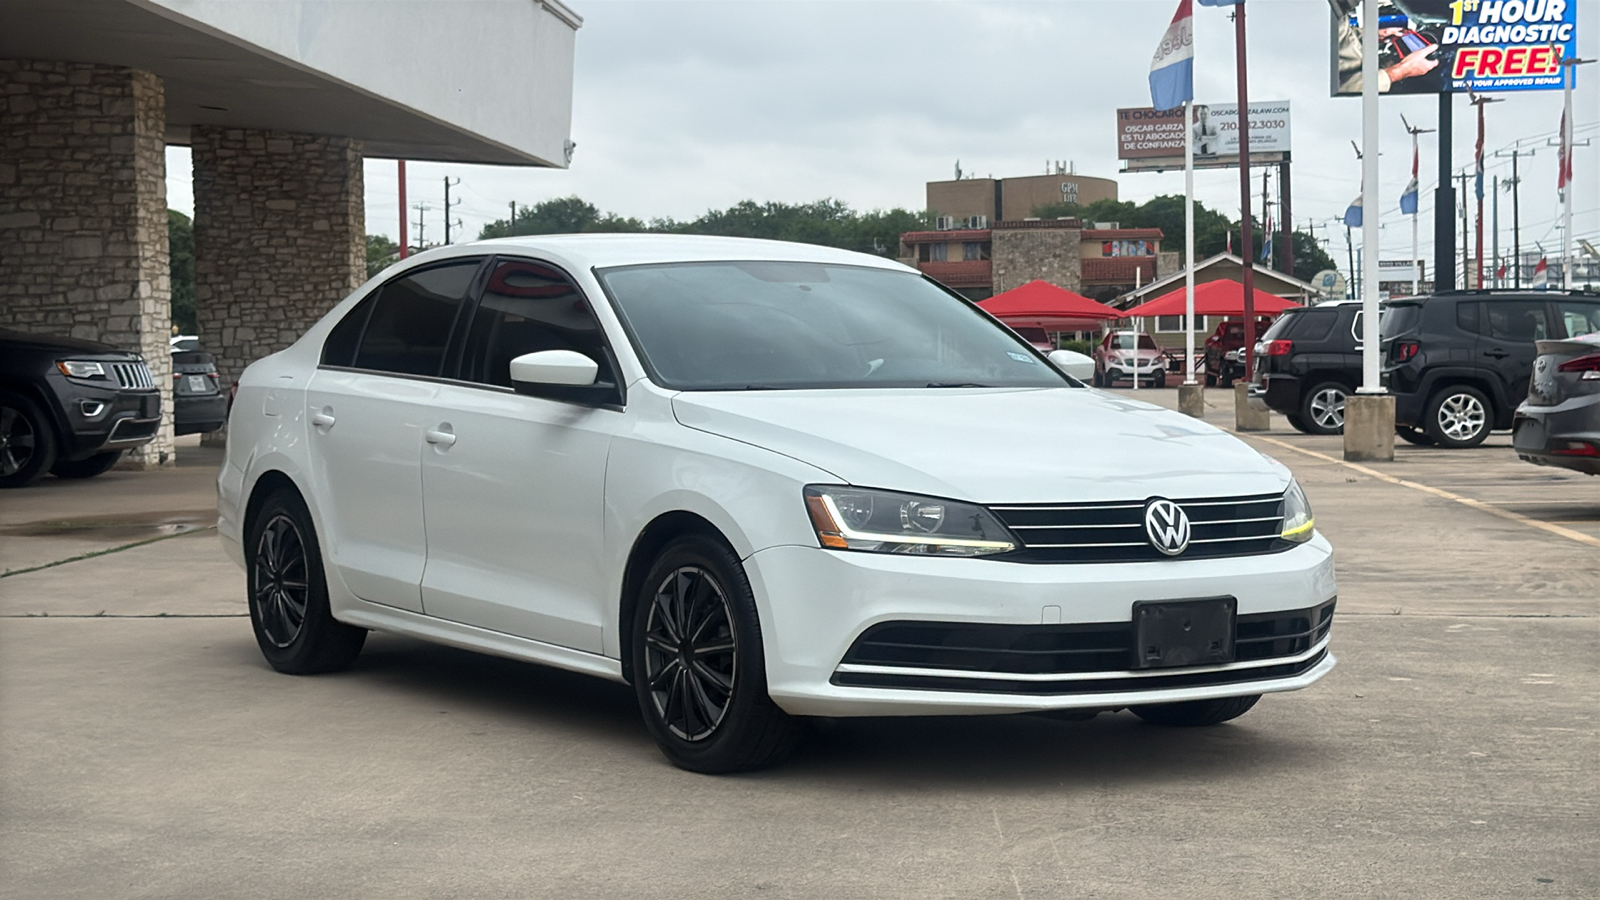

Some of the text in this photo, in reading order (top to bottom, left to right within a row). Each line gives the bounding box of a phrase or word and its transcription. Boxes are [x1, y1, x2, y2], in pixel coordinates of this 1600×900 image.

[1478, 0, 1566, 24] HOUR
[1441, 24, 1572, 45] DIAGNOSTIC
[1453, 46, 1563, 78] FREE!
[1473, 79, 1494, 87] YOUR
[1494, 78, 1534, 87] APPROVED
[1534, 77, 1562, 86] REPAIR
[1120, 111, 1131, 120] TE
[1125, 123, 1184, 133] OSCAR GARZA
[1220, 120, 1286, 131] 210.2.3030
[1121, 134, 1132, 142] ES
[1133, 133, 1144, 141] TU
[1124, 140, 1186, 150] DE CONFIANZA
[1145, 499, 1191, 556] VW
